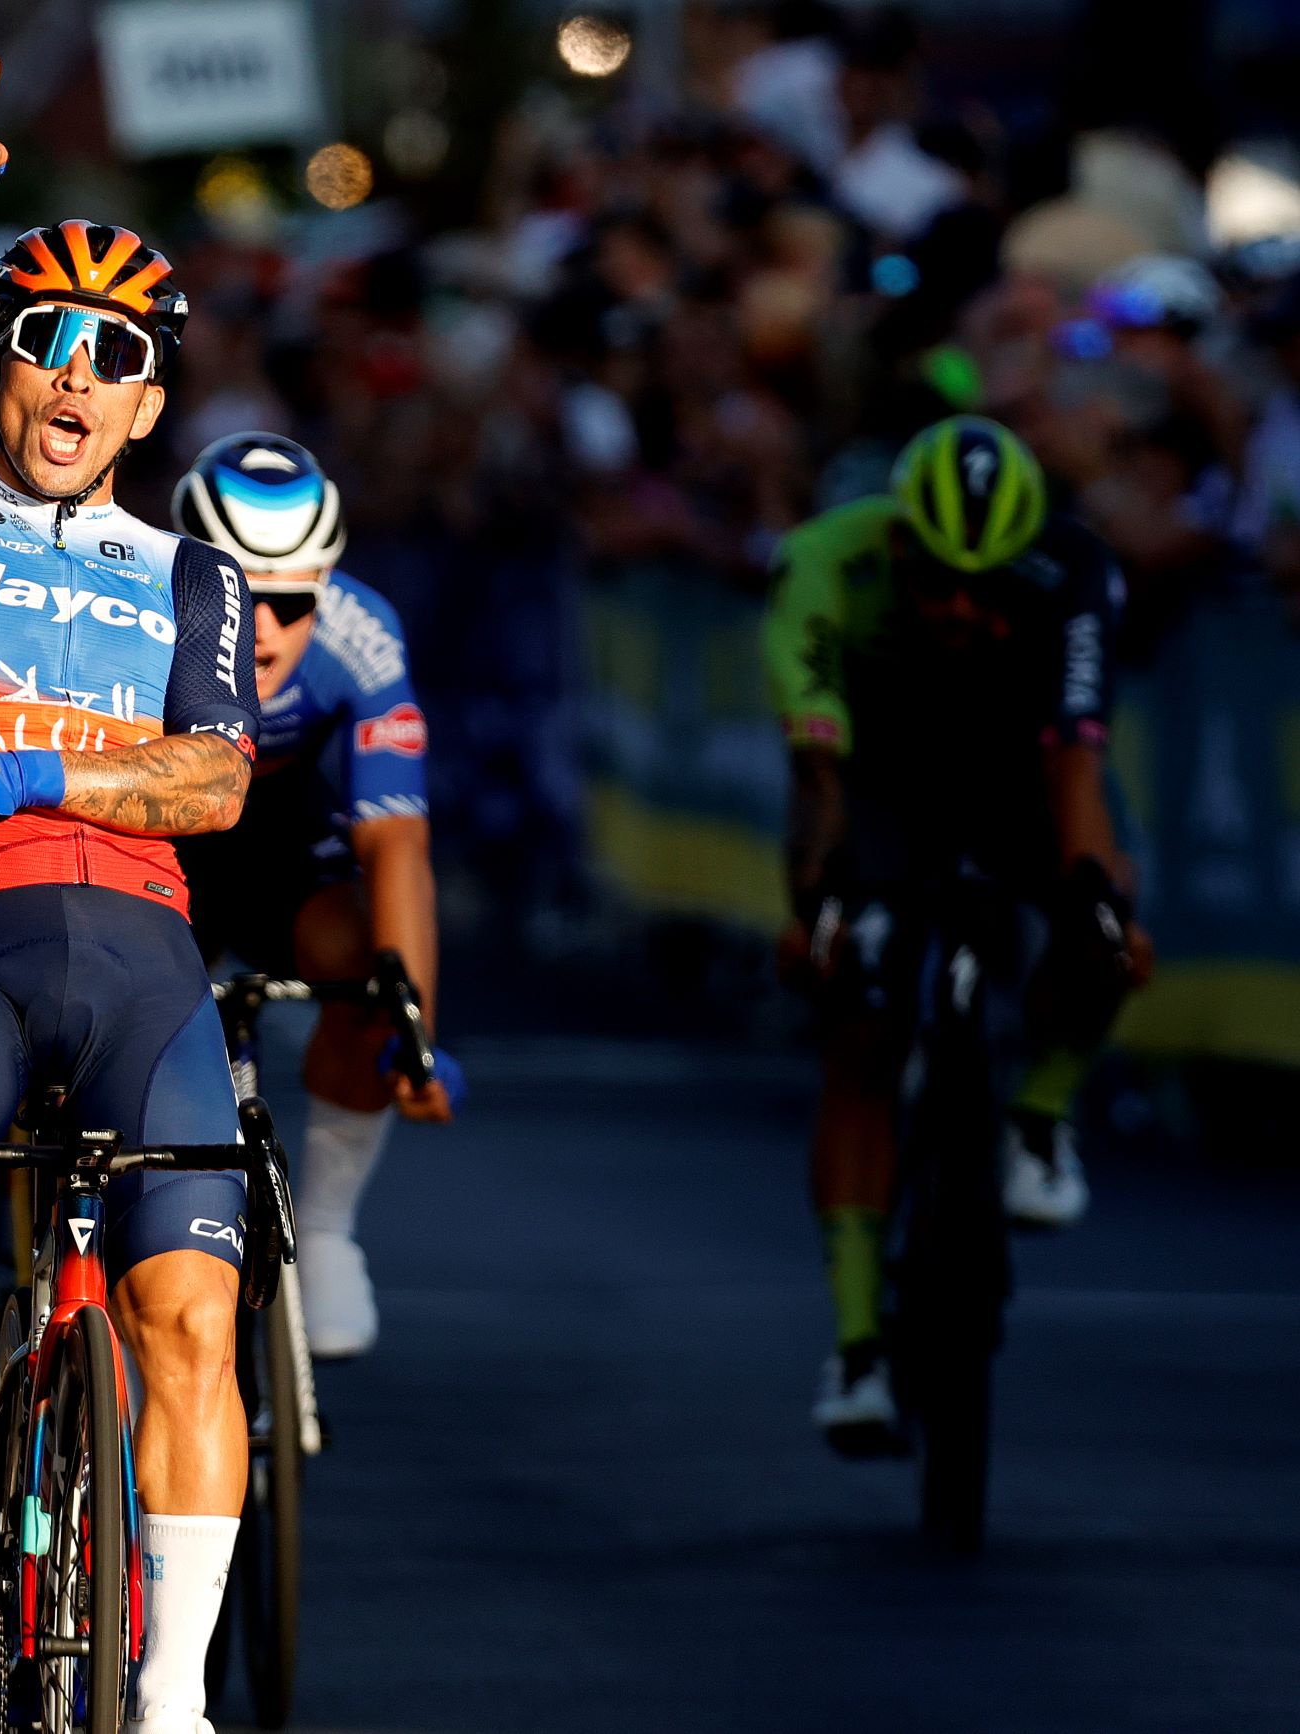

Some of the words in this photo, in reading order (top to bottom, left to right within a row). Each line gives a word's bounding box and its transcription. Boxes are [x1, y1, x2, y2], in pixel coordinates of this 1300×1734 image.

[84, 560, 152, 585] GreenEDGE
[217, 564, 241, 697] GIANT
[81, 1130, 110, 1138] GARMIN
